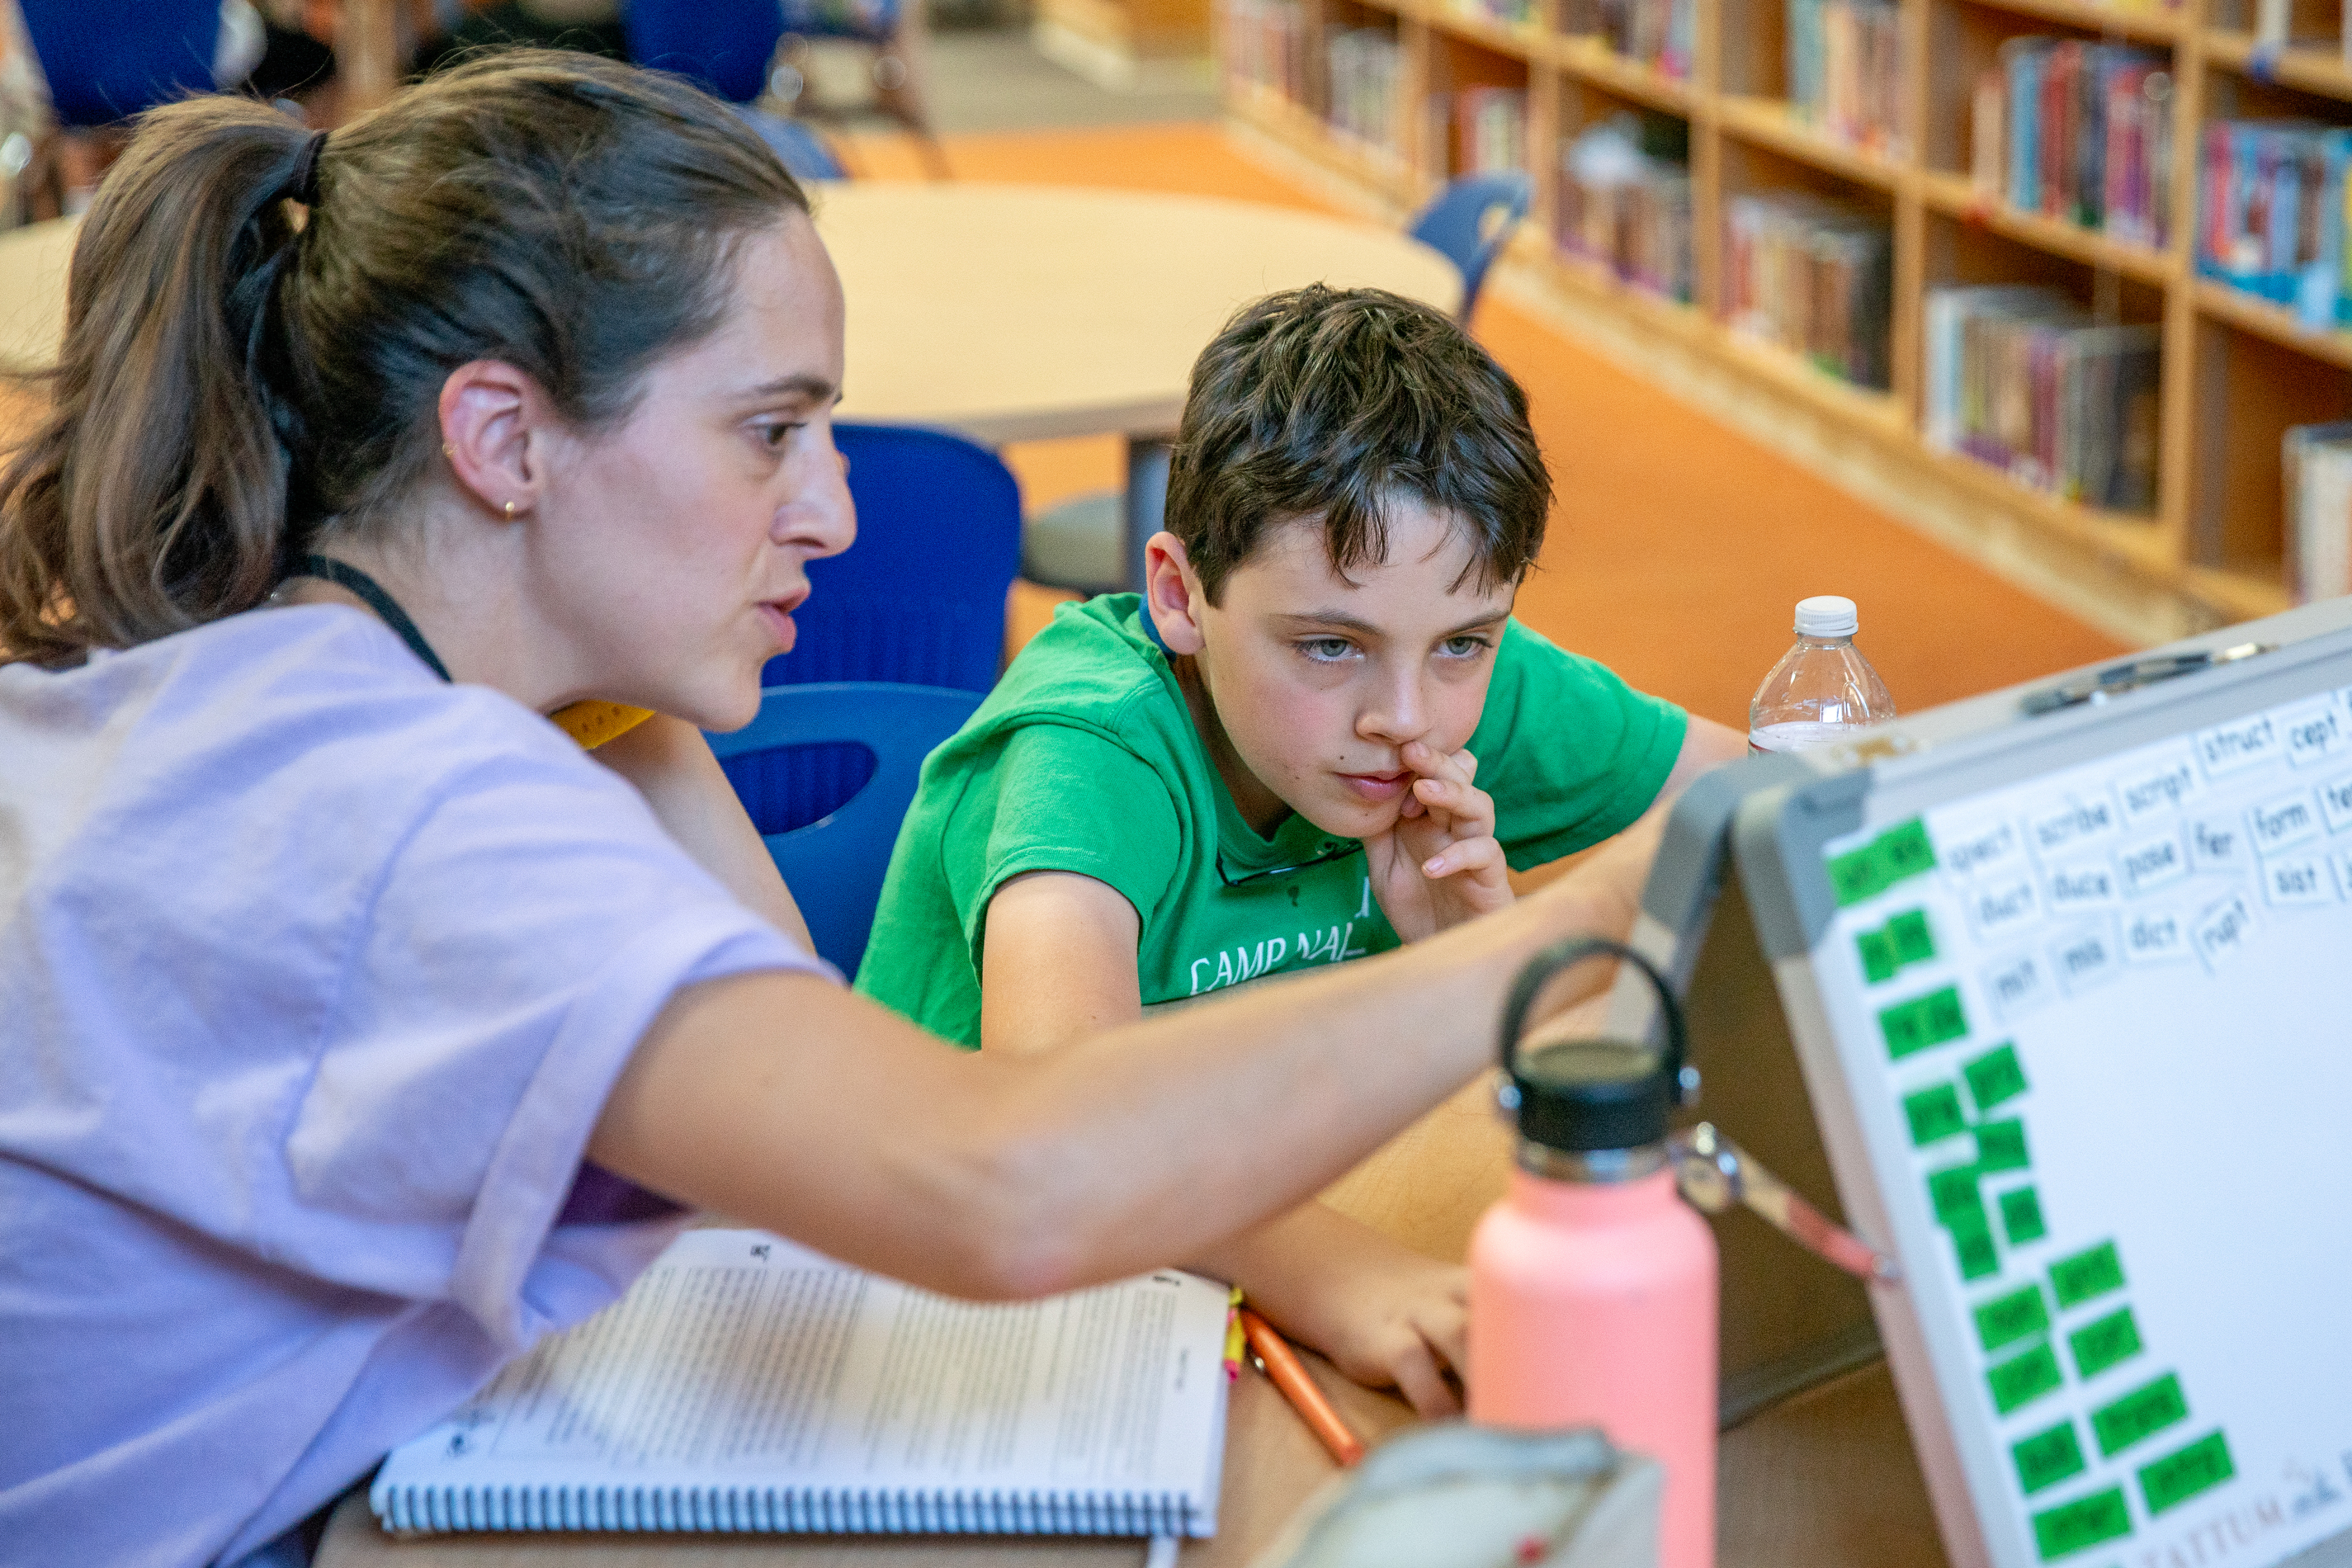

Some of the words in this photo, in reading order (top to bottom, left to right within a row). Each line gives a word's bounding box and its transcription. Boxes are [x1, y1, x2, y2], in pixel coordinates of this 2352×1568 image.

[2125, 763, 2192, 814] script
[2205, 716, 2274, 765] struct
[2289, 710, 2339, 754] cept
[1981, 882, 2033, 926] duct
[2055, 871, 2109, 902] duce
[2194, 820, 2233, 858] fer
[2253, 804, 2311, 843] form
[2327, 782, 2352, 815] te
[2131, 914, 2177, 951] dict
[2202, 897, 2251, 956] rupt
[2275, 860, 2317, 895] sist
[1190, 937, 1287, 995] CAMP
